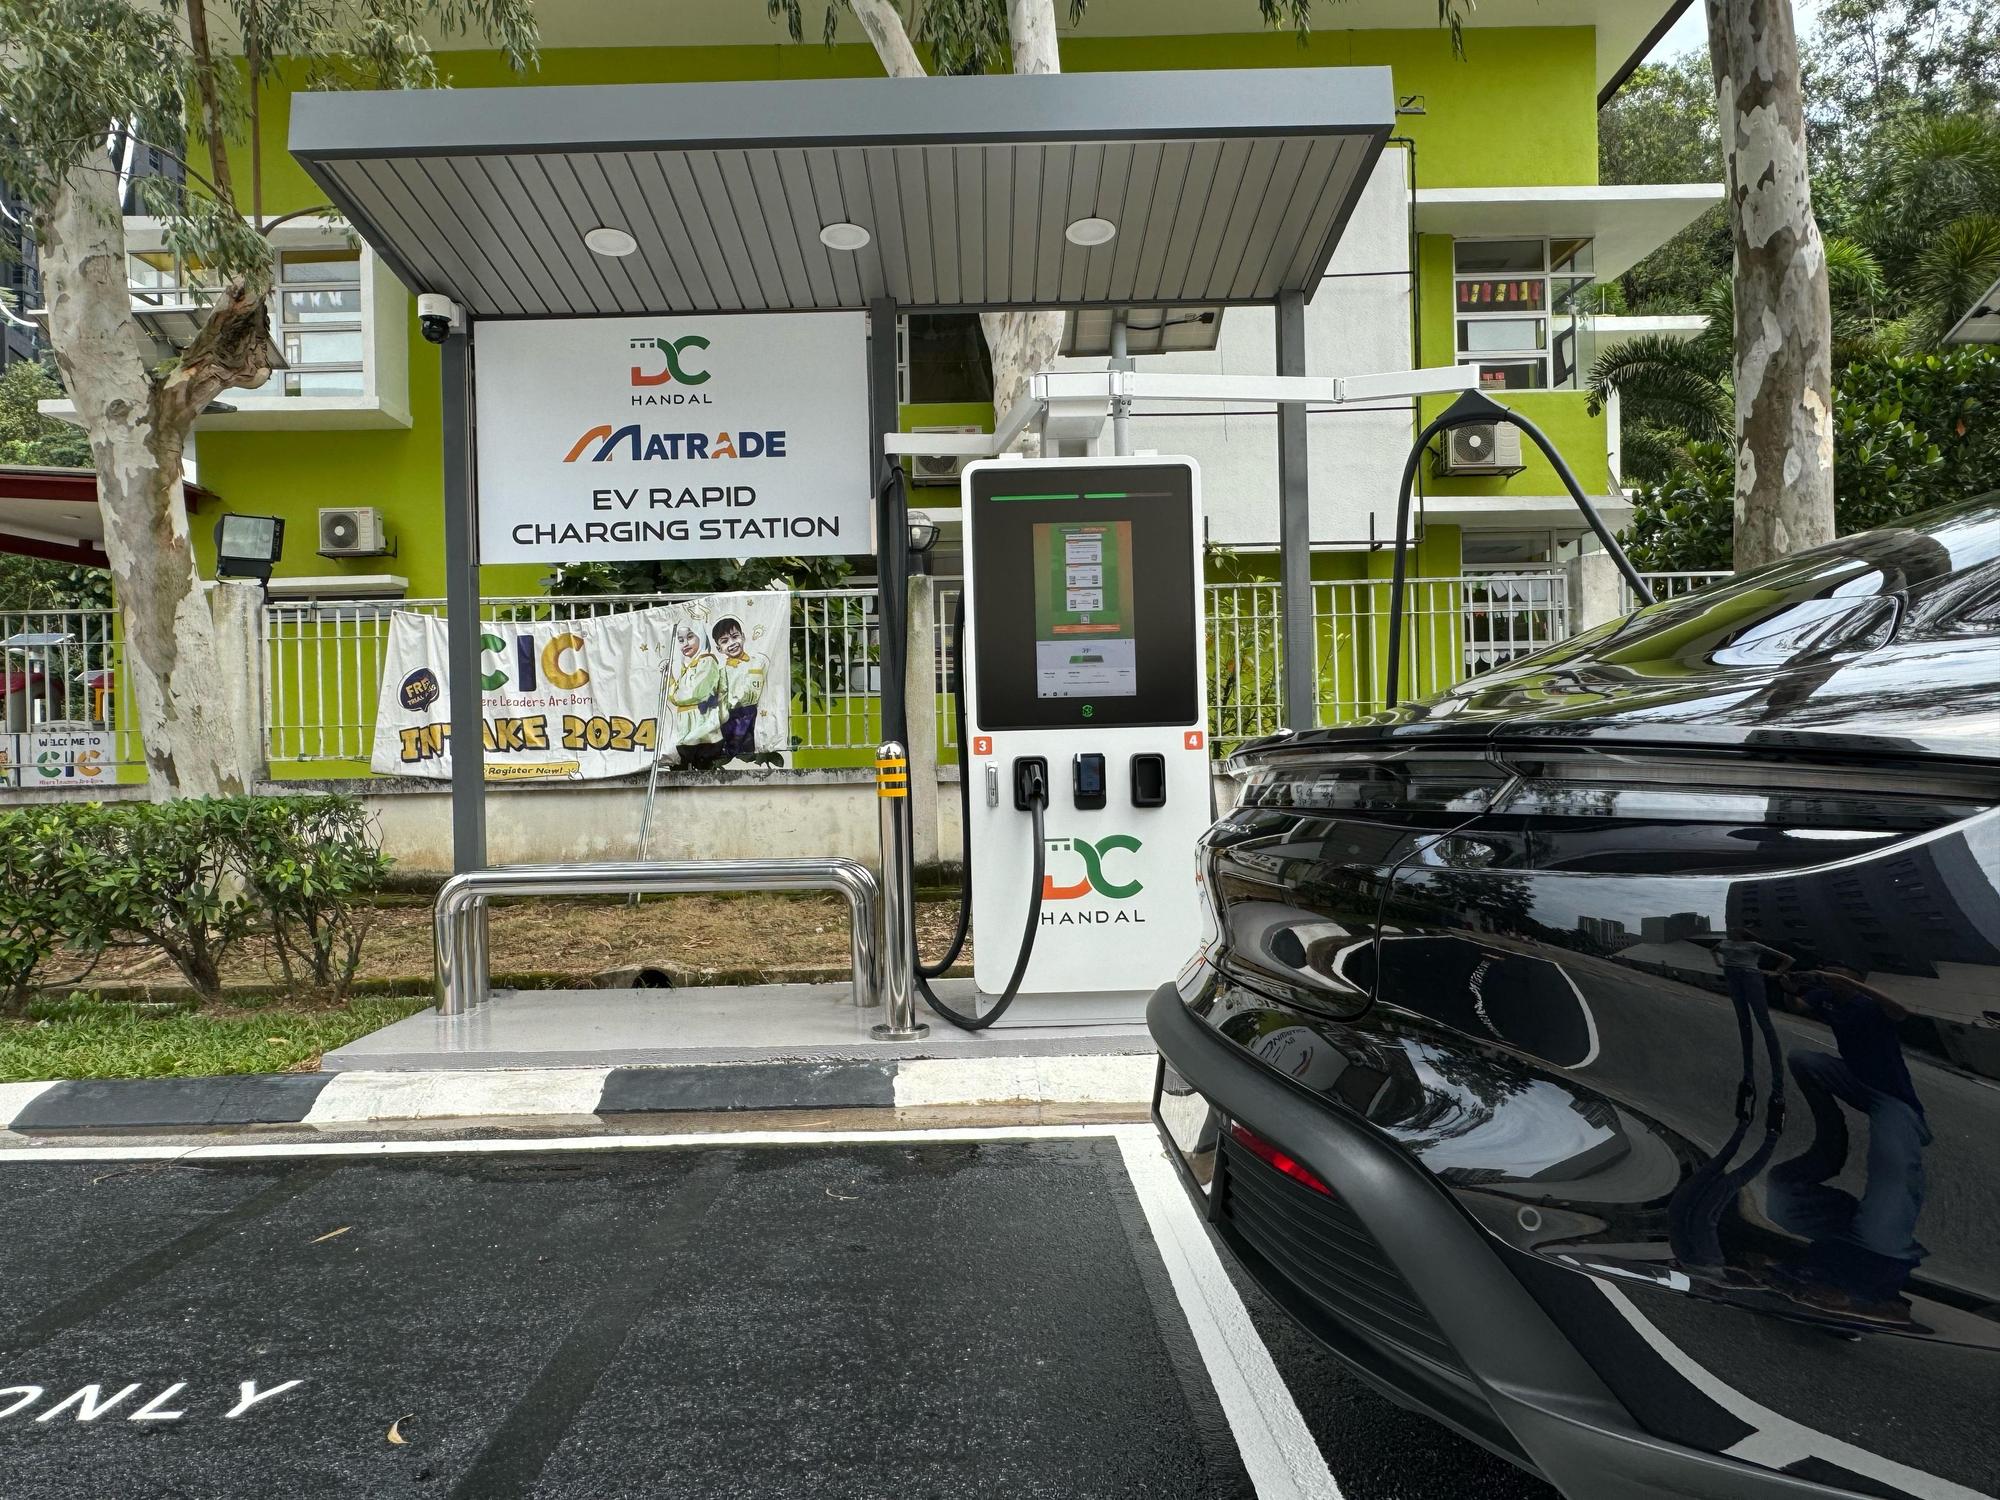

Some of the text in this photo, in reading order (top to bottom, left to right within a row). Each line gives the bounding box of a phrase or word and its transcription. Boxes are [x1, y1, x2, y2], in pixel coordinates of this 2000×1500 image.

[631, 393, 713, 406] HANDAL
[562, 424, 787, 463] MATRADE
[593, 486, 756, 510] EV RAPID
[512, 515, 840, 545] CHARGING STATION
[481, 698, 498, 707] ere
[500, 695, 546, 707] Leaders
[548, 695, 568, 706] Are
[562, 714, 658, 752] 2024
[1188, 735, 1198, 746] 4
[978, 740, 987, 752] 3
[37, 750, 102, 778] CIC
[1041, 909, 1146, 926] HANDAL
